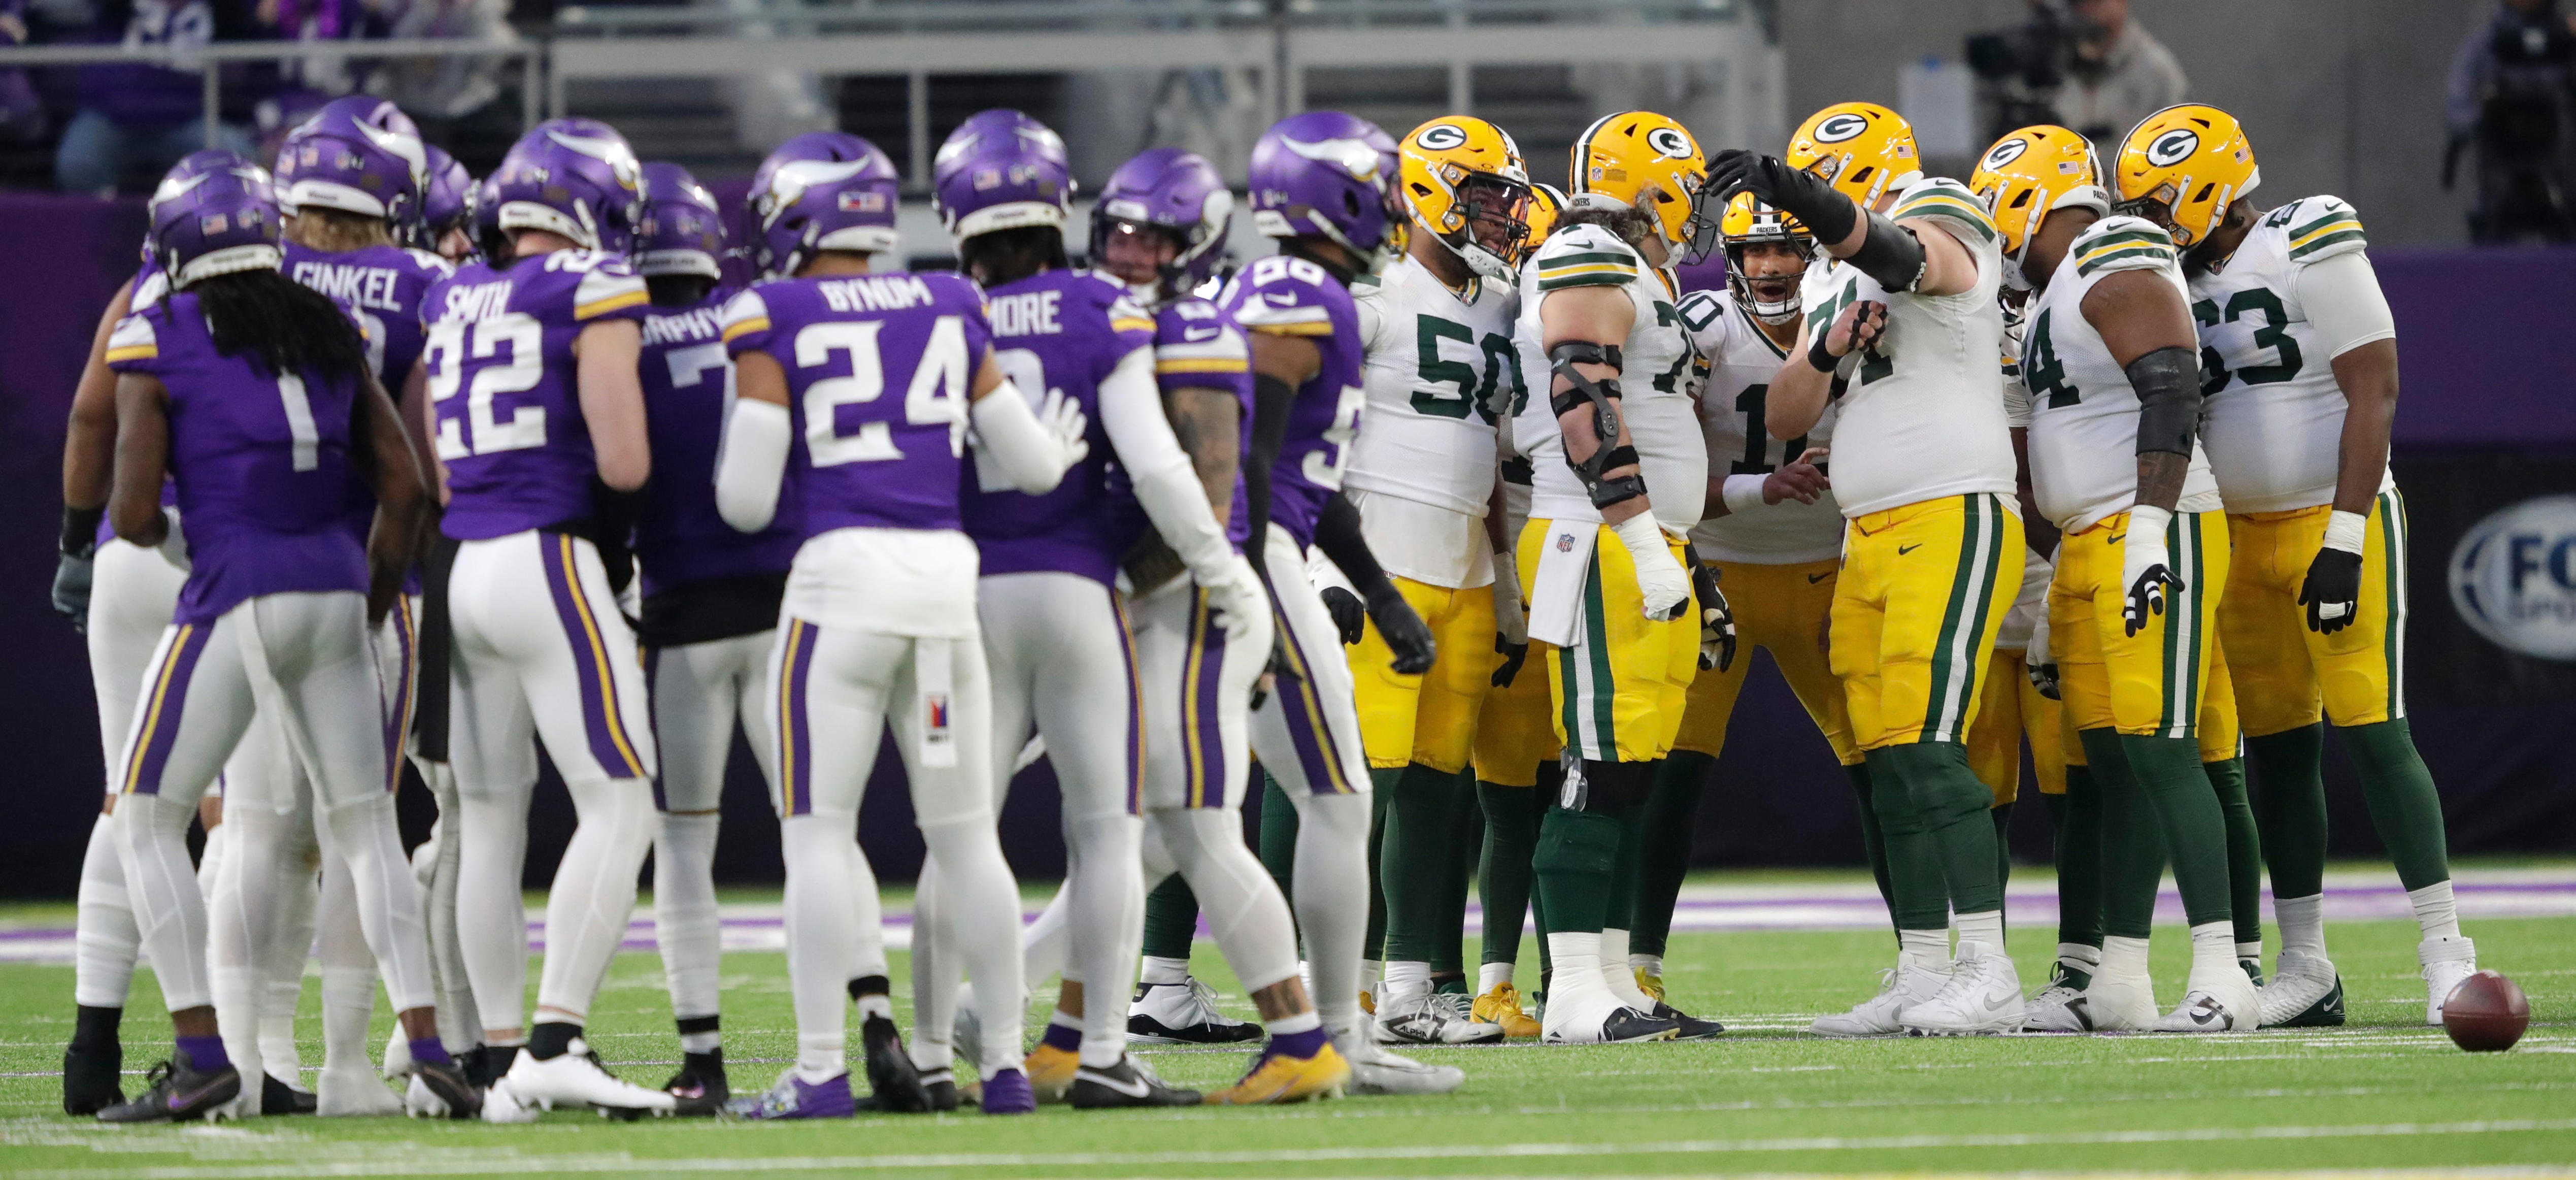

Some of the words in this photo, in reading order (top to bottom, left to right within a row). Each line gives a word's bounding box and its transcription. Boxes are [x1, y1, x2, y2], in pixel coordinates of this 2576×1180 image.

[1417, 124, 1466, 151] G
[1647, 127, 1693, 160] G
[1814, 113, 1868, 144] G
[2146, 128, 2199, 168] G
[1982, 138, 2028, 172] G
[293, 260, 402, 312] GINKEL
[440, 279, 513, 325] SMITH
[818, 276, 934, 312] BYNUM
[1410, 313, 1514, 428] 50
[2020, 306, 2082, 410] 4
[423, 311, 547, 461] 22
[794, 315, 970, 468] 24
[1399, 1025, 1428, 1038] ALPHA
